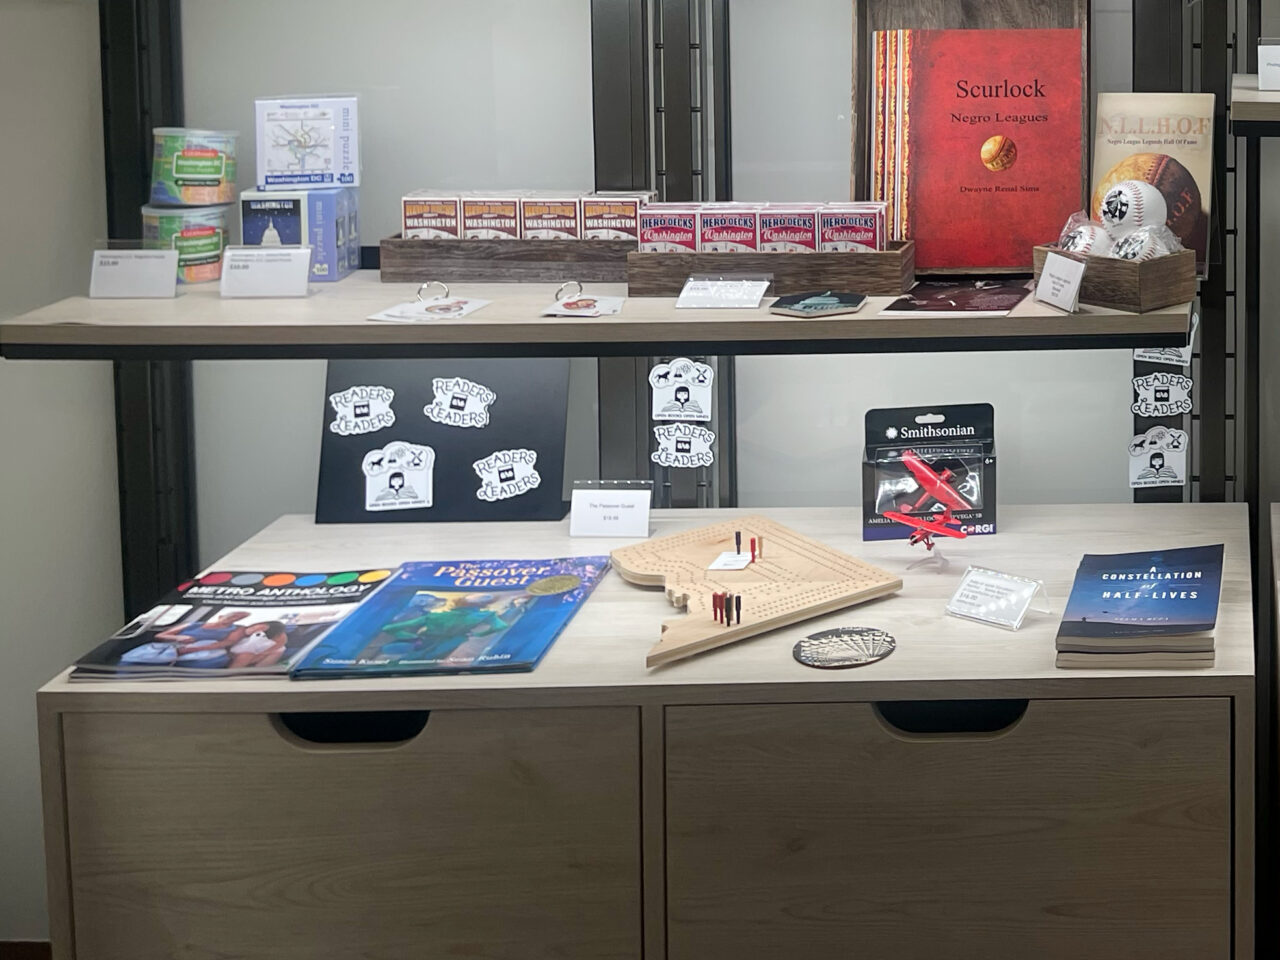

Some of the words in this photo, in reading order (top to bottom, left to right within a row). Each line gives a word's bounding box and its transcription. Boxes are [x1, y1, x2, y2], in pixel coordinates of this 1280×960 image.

[956, 79, 1047, 98] Scurlock
[951, 113, 991, 125] Negro
[995, 113, 1049, 125] Leagues
[267, 175, 310, 184] Washington
[250, 201, 294, 209] WASHINGTON
[406, 218, 456, 227] WASHINGTON
[465, 219, 515, 227] WASHINGTON
[525, 219, 576, 228] WASHINGTON
[586, 219, 636, 228] WASHINGTON
[641, 217, 666, 229] HERO
[668, 217, 693, 229] DECKS
[702, 217, 727, 229] HERO
[729, 217, 754, 229] DECKS
[761, 217, 786, 229] HERO
[788, 217, 813, 229] DECKS
[822, 217, 847, 229] HERO
[849, 217, 874, 229] DECKS
[642, 230, 693, 240] Washington
[702, 230, 753, 240] Washington
[762, 230, 813, 240] Washington
[822, 230, 874, 240] Washington
[1135, 374, 1192, 390] READERS
[435, 380, 493, 404] READERS
[333, 389, 393, 408] READERS
[1133, 397, 1192, 414] LEADERS
[426, 401, 485, 425] LEADERS
[332, 411, 394, 432] LEADERS
[657, 425, 715, 443] READERS
[901, 425, 975, 439] Smithsonian
[653, 447, 712, 465] LEADERS
[477, 451, 534, 475] READERS
[479, 473, 538, 499] LEADERS
[961, 524, 994, 533] CORGI
[434, 565, 550, 578] Passover
[1102, 571, 1202, 580] CONSTELLATION
[453, 575, 529, 587] Guest
[188, 586, 255, 595] METRO
[256, 584, 372, 596] ANTHOLOGY
[1102, 591, 1198, 599] HALF-LIVES
